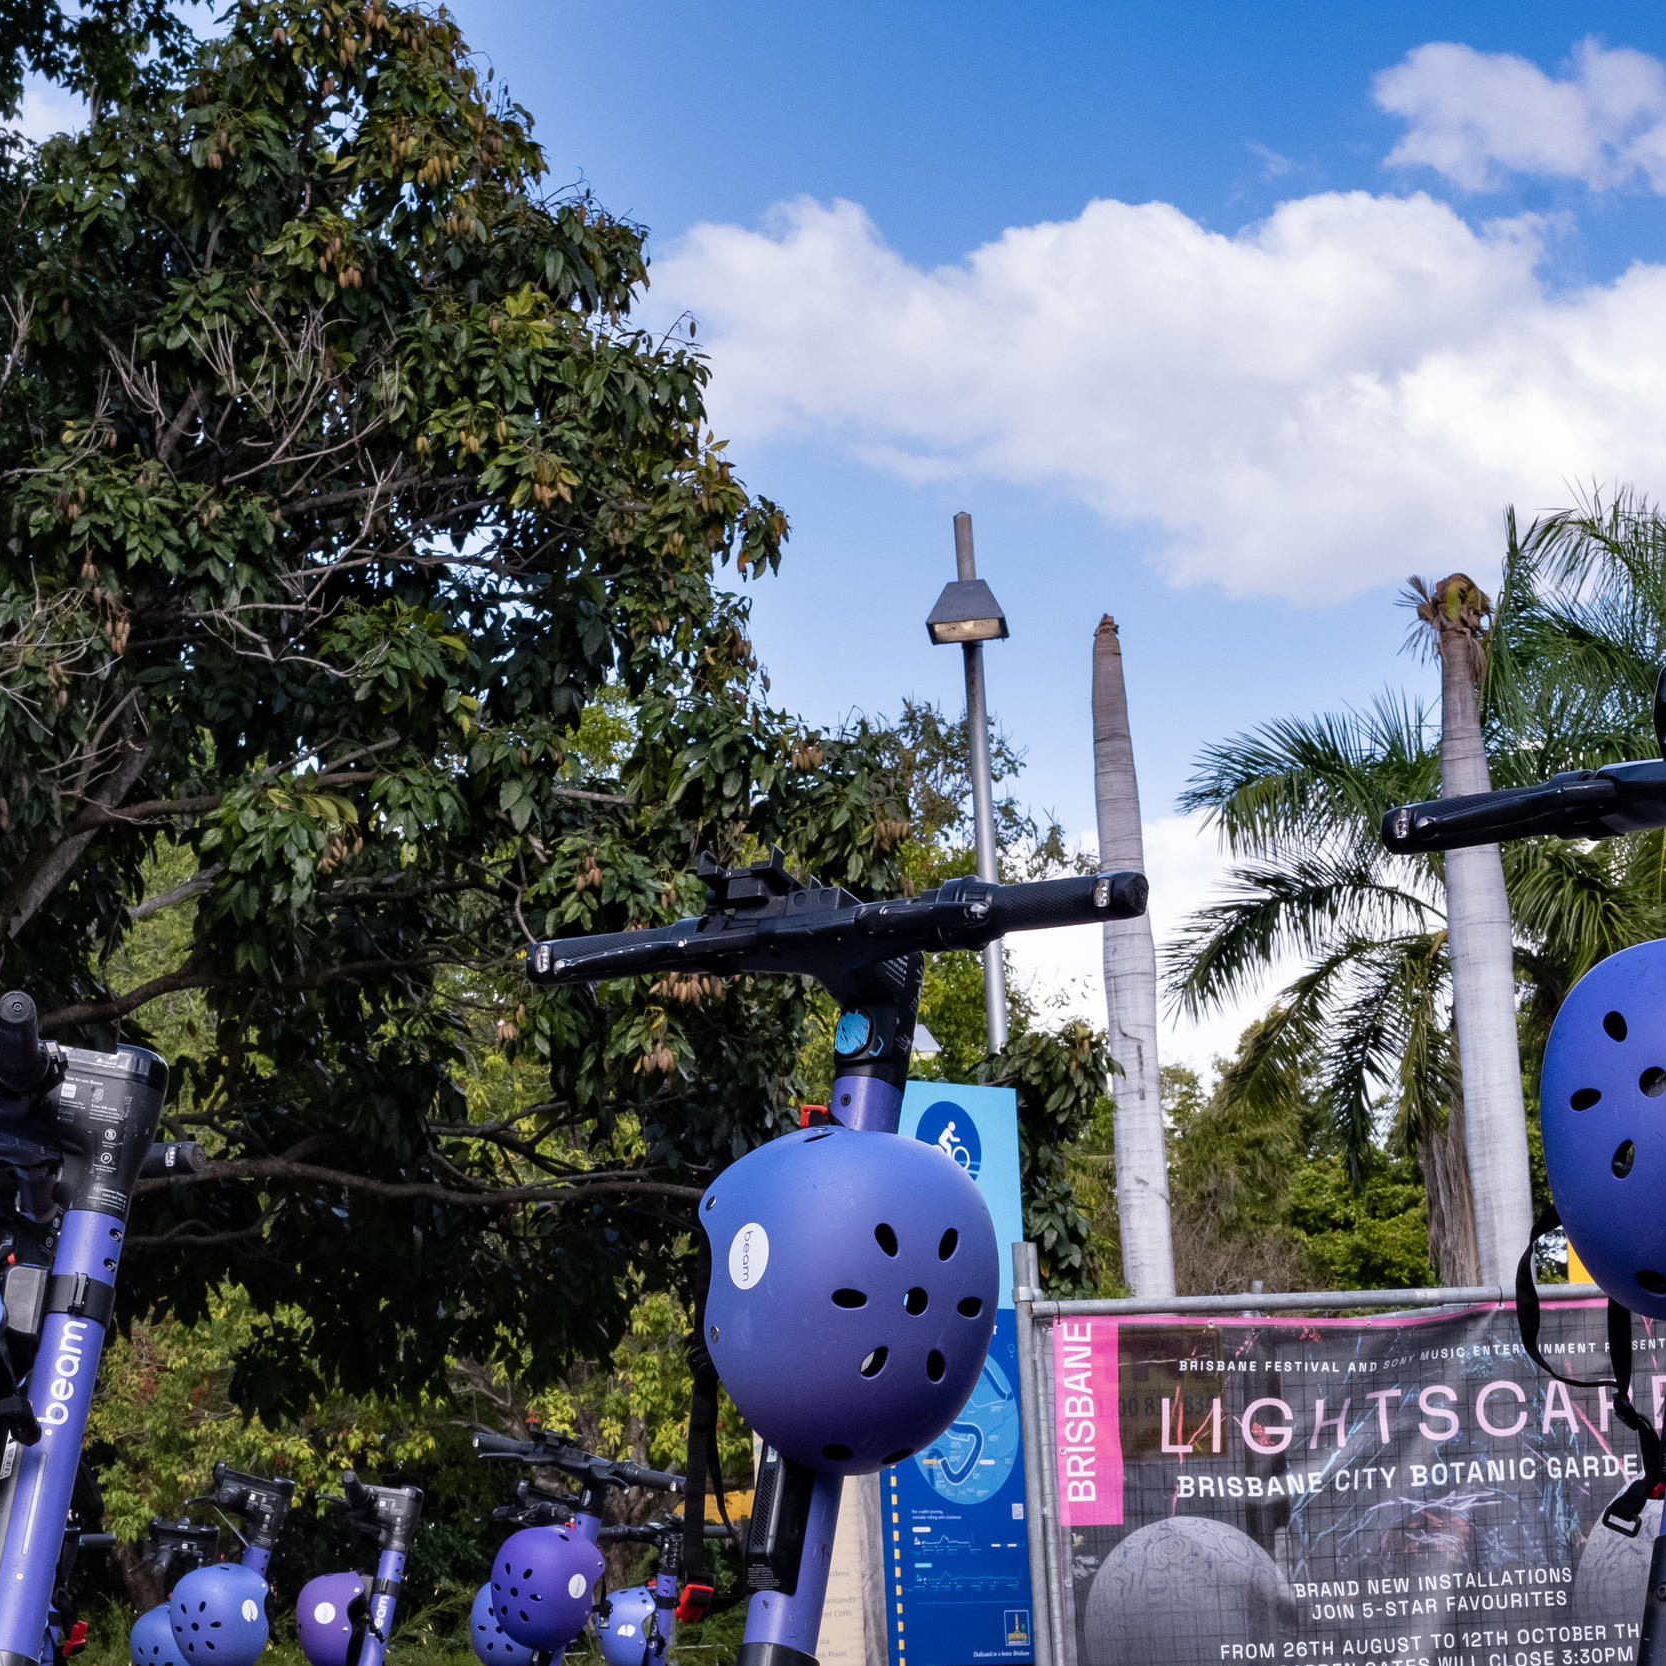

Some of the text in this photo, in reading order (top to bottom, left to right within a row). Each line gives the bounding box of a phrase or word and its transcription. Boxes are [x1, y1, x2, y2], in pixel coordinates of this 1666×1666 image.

[743, 1230, 754, 1282] beam
[36, 1320, 88, 1427] beam
[1179, 1360, 1257, 1372] BRISBANE
[1264, 1360, 1340, 1374] FESTIVAL
[1347, 1360, 1378, 1373] AND
[1383, 1353, 1416, 1370] SONY
[1419, 1346, 1465, 1361] MUSIC
[1473, 1342, 1596, 1357] ENTERTINMENT
[1063, 1322, 1096, 1502] BRISBANE
[1177, 1472, 1324, 1498] BRISBANE
[1335, 1467, 1397, 1492] CITY
[1410, 1457, 1537, 1488] BOTANIC
[1547, 1454, 1638, 1480] GARDE
[1294, 1567, 1573, 1598] BRAND NEW INSTALLATIONS
[1312, 1590, 1567, 1620] JOIN 5-STAR FAVOURITES
[1220, 1643, 1275, 1660] FROM
[1283, 1640, 1334, 1658] 26TH
[1342, 1635, 1422, 1655] AUGUST
[1431, 1633, 1455, 1649] TO
[1462, 1630, 1509, 1648] 12TH
[1517, 1624, 1607, 1644] OCTOBER
[1562, 1646, 1634, 1665] 3:30PM
